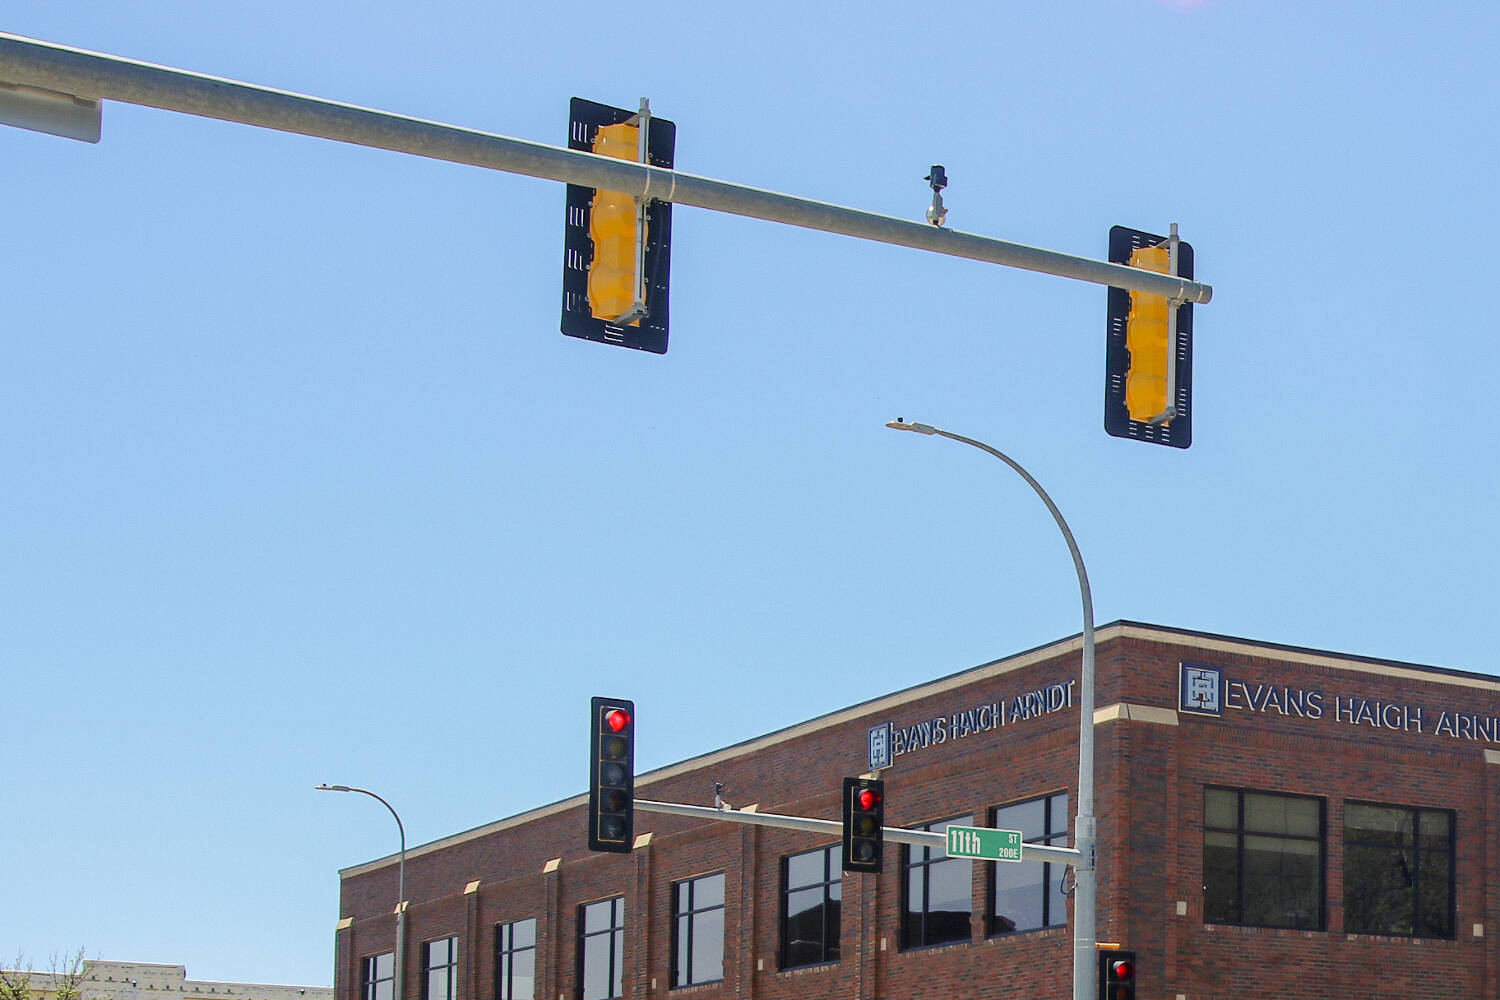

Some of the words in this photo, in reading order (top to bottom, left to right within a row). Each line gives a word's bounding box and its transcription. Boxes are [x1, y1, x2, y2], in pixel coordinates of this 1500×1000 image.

[892, 717, 947, 756] EVANS
[950, 701, 1005, 740] HAIGH
[1009, 680, 1076, 724] ARNDT
[1225, 679, 1322, 720] EVANS
[1335, 696, 1423, 734] HAIGH
[951, 830, 981, 855] 11th
[1008, 833, 1019, 844] ST
[998, 847, 1019, 859] 200E
